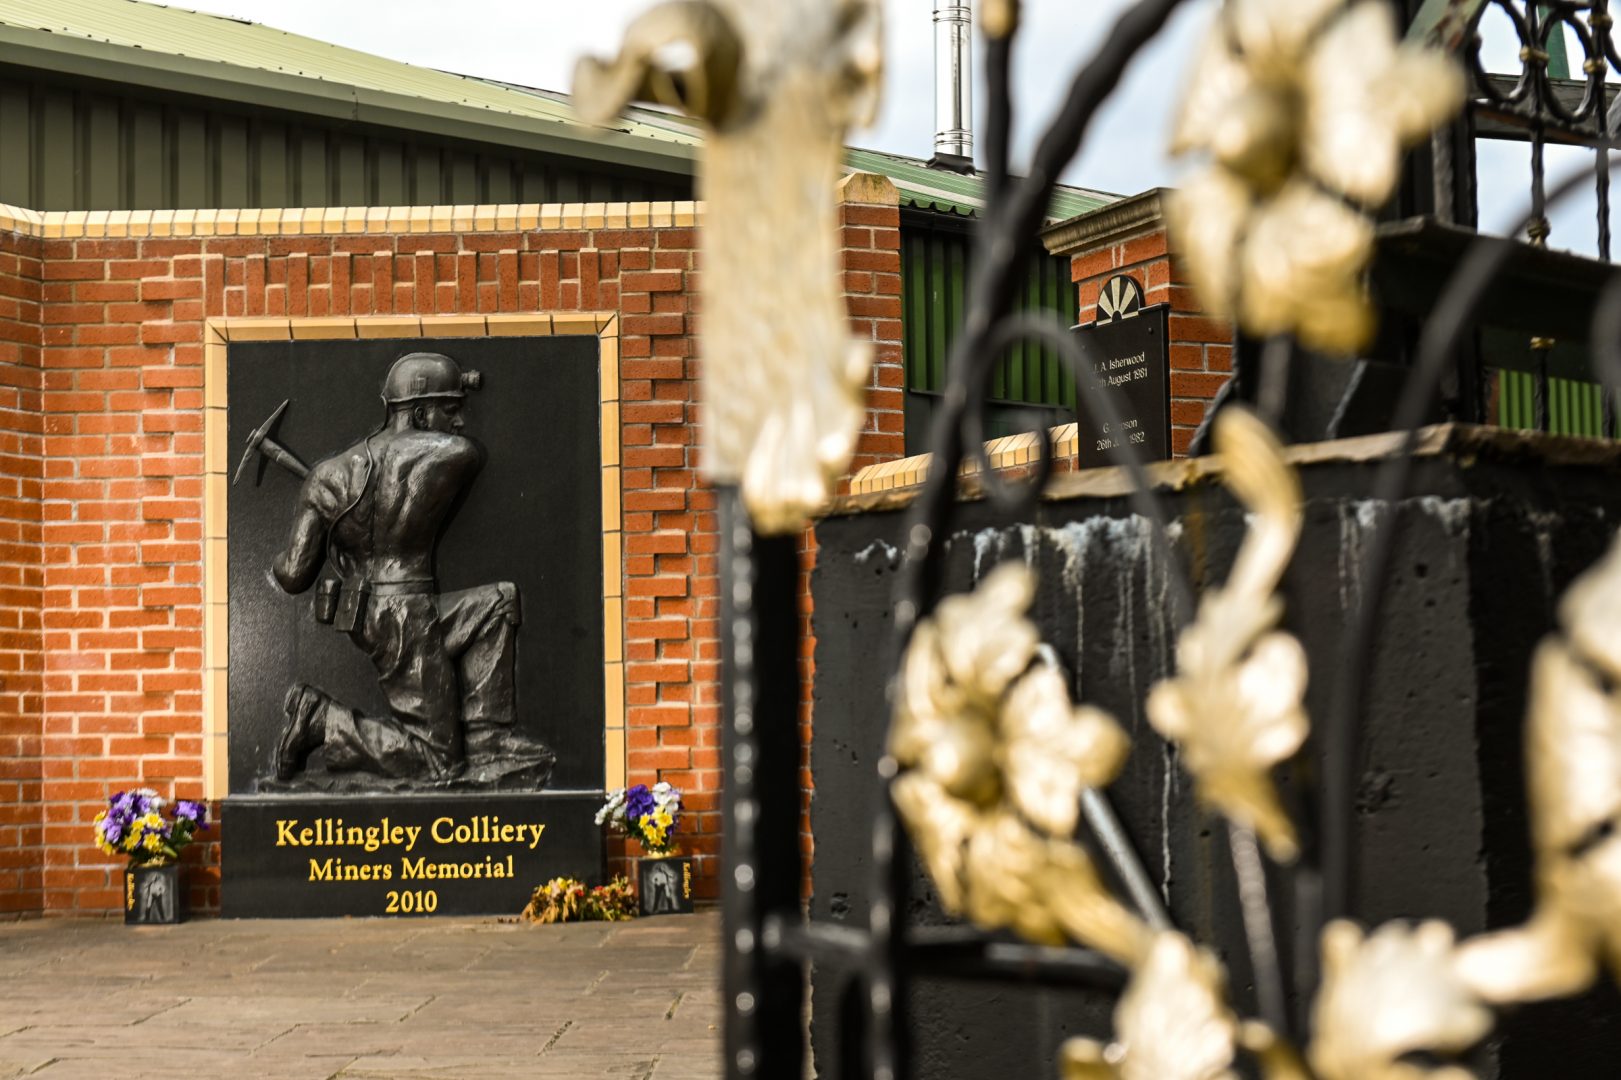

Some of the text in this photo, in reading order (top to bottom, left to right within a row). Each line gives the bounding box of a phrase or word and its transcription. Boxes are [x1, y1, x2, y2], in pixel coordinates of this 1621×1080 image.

[1109, 351, 1145, 370] Isherwood
[1107, 371, 1131, 387] August
[1133, 367, 1148, 380] 1981
[276, 815, 546, 852] Kellingley Colliery
[308, 854, 514, 881] Miners Memorial
[385, 890, 438, 913] 2010
